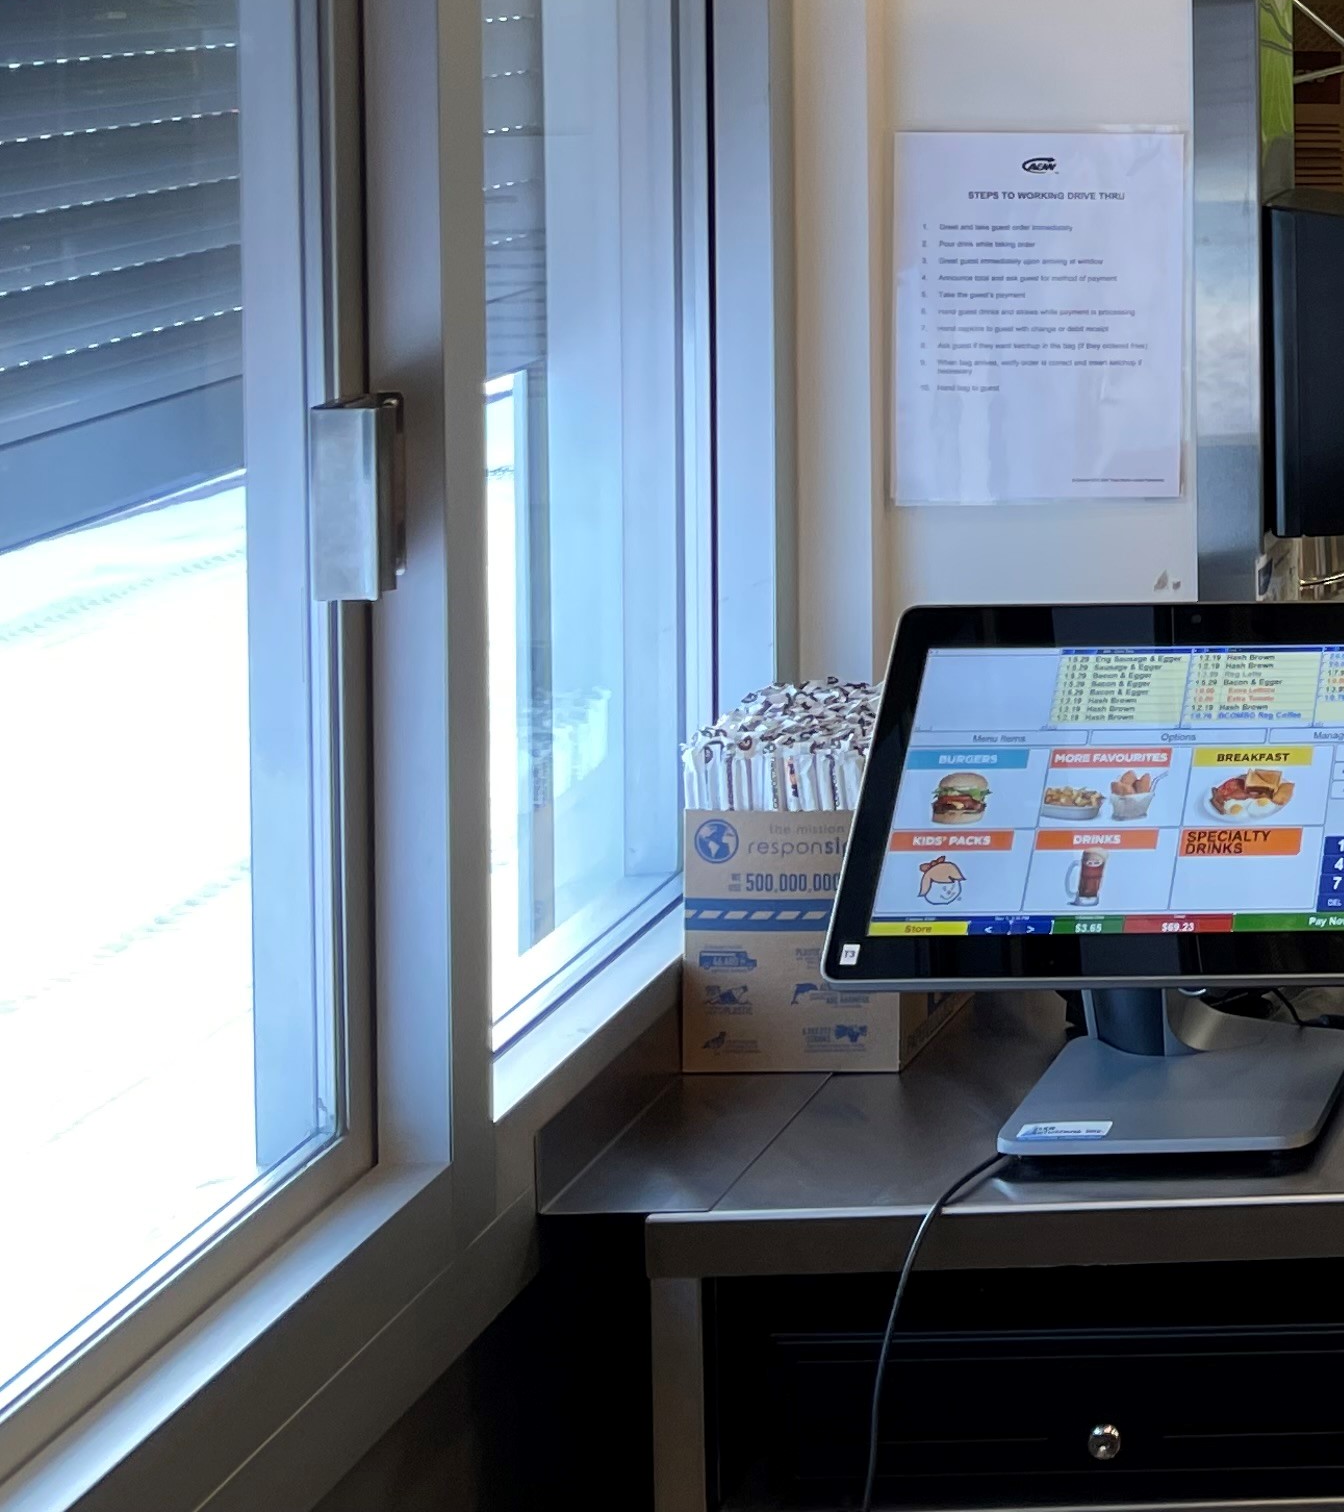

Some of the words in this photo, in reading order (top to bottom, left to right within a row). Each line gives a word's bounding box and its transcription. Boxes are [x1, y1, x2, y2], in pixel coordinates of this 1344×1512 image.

[968, 192, 999, 200] STEPS
[1018, 192, 1064, 200] WORKING
[1067, 192, 1096, 200] DRIVE
[1099, 192, 1125, 200] THRU
[1161, 732, 1196, 742] Options
[939, 754, 998, 765] BURGERS
[1054, 754, 1090, 764] MORE
[1092, 752, 1168, 763] FAVOURITES
[1216, 752, 1290, 762] BREAKFAST
[949, 835, 991, 845] PACKS
[1073, 834, 1121, 845] DRINKS
[1187, 830, 1271, 843] SPECIALTY
[1185, 843, 1243, 854] DRINKS
[1334, 858, 1344, 871] 4
[1333, 877, 1342, 890] 7
[1075, 923, 1102, 933] $3.65
[1161, 922, 1195, 932] $69.23
[1308, 918, 1327, 928] Pay
[904, 925, 932, 933] Store
